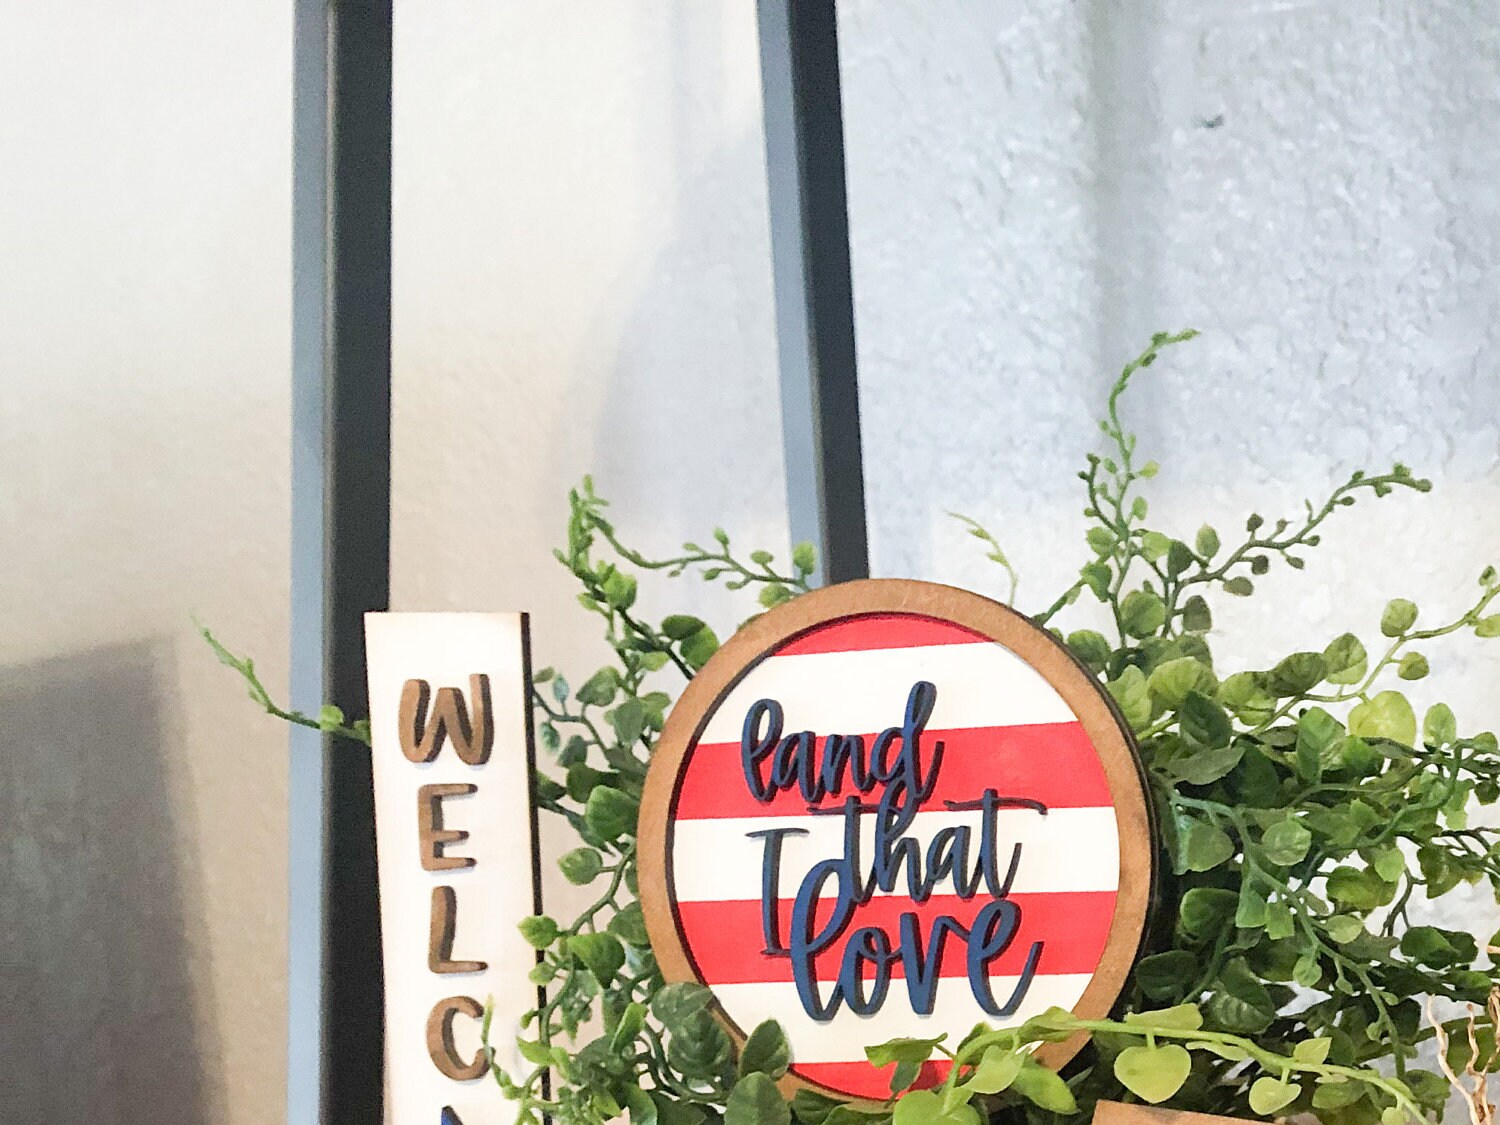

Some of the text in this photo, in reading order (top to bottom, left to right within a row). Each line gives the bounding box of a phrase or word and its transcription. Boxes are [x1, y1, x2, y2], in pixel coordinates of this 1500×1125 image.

[740, 681, 945, 803] land
[808, 788, 1048, 905] that
[789, 858, 1045, 1022] love
